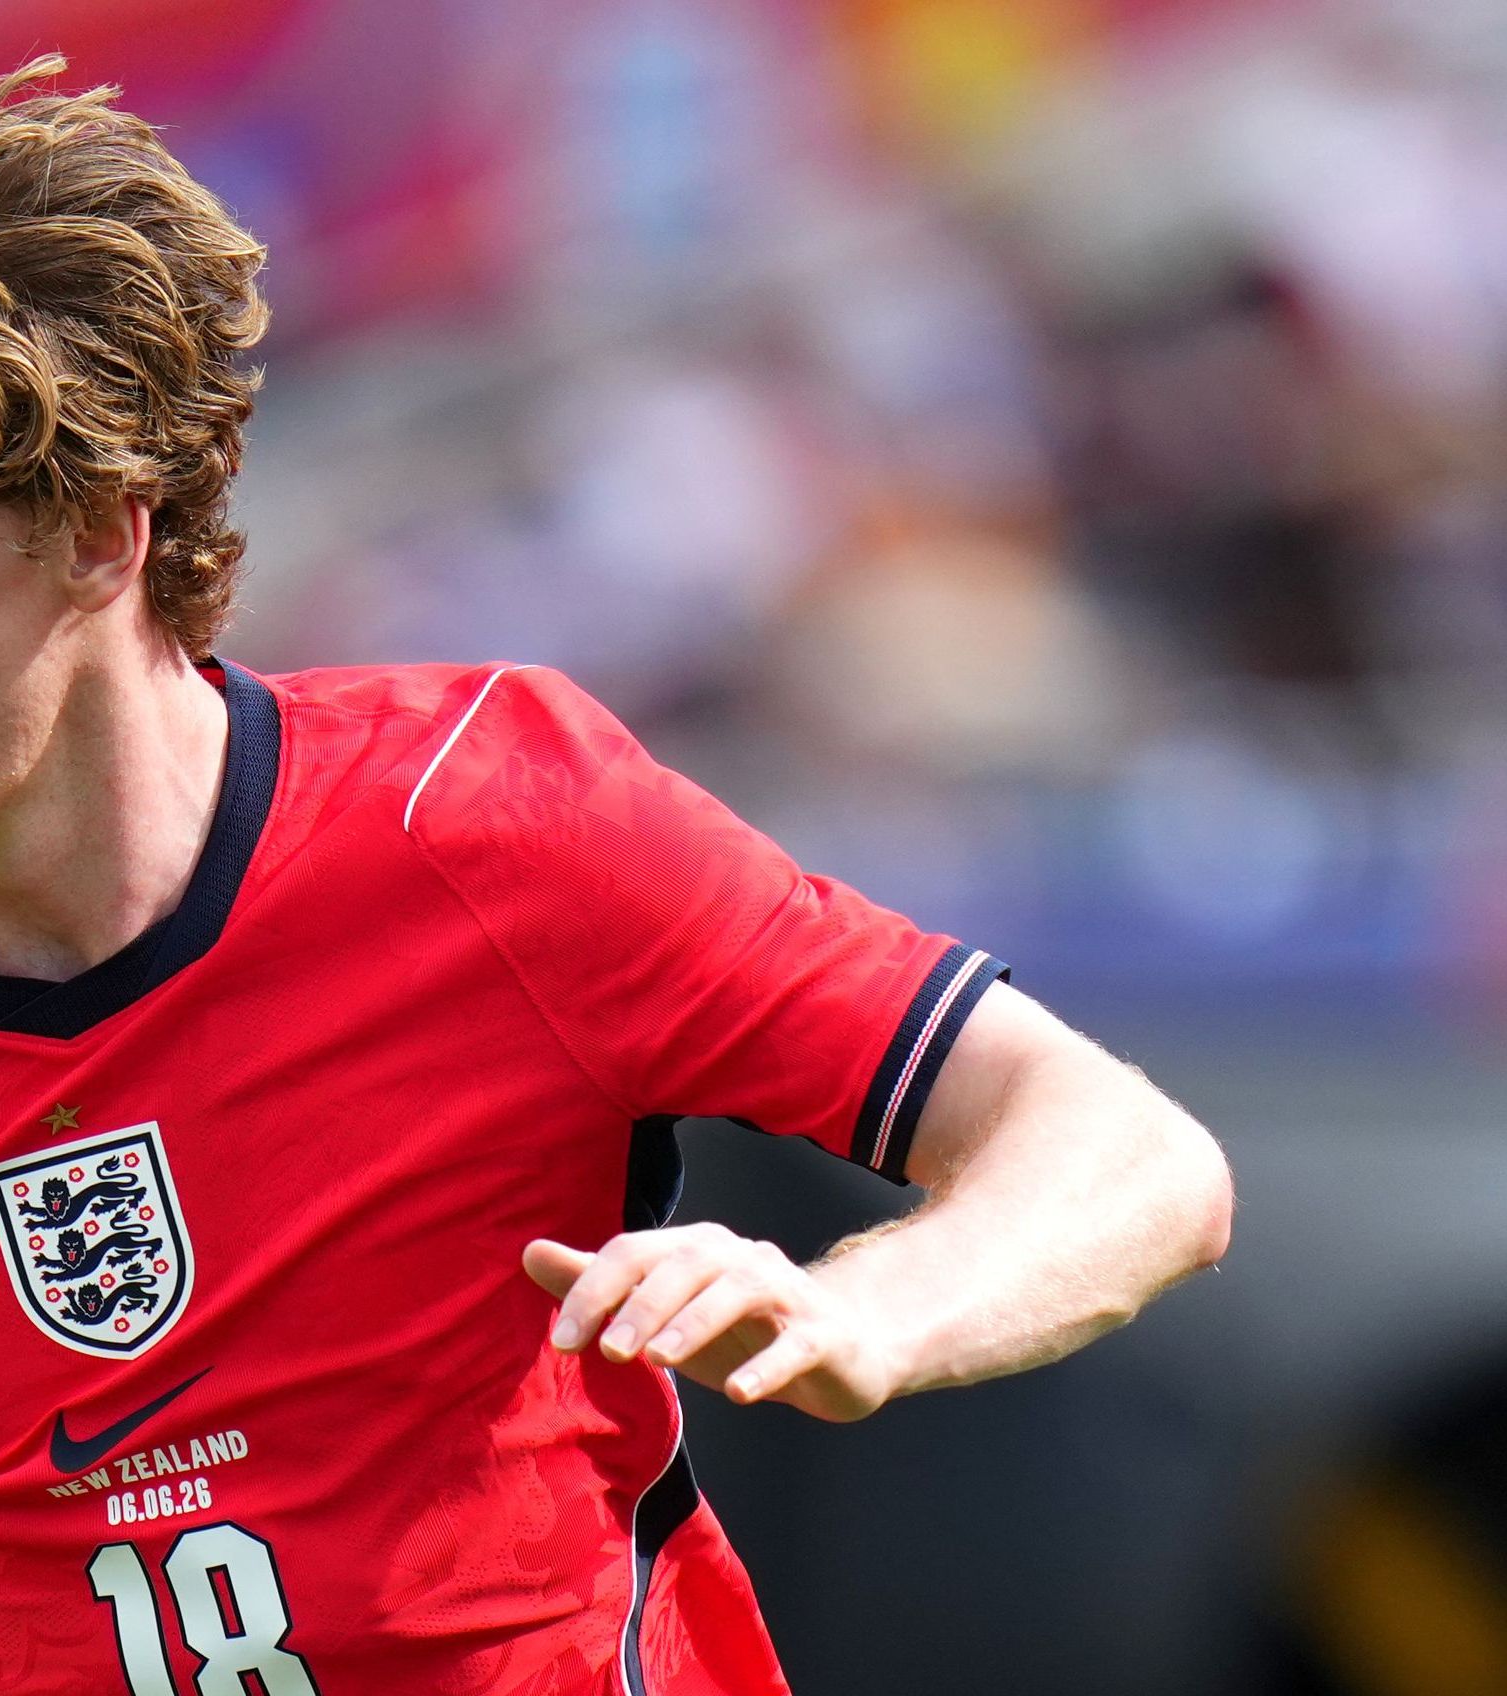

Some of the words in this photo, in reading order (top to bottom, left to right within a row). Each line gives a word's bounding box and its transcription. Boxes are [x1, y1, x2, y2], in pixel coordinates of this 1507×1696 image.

[47, 1468, 112, 1498] NEW
[114, 1430, 249, 1484] ZEALAND
[107, 1477, 213, 1526] 06.06.26
[85, 1520, 321, 1696] 18
